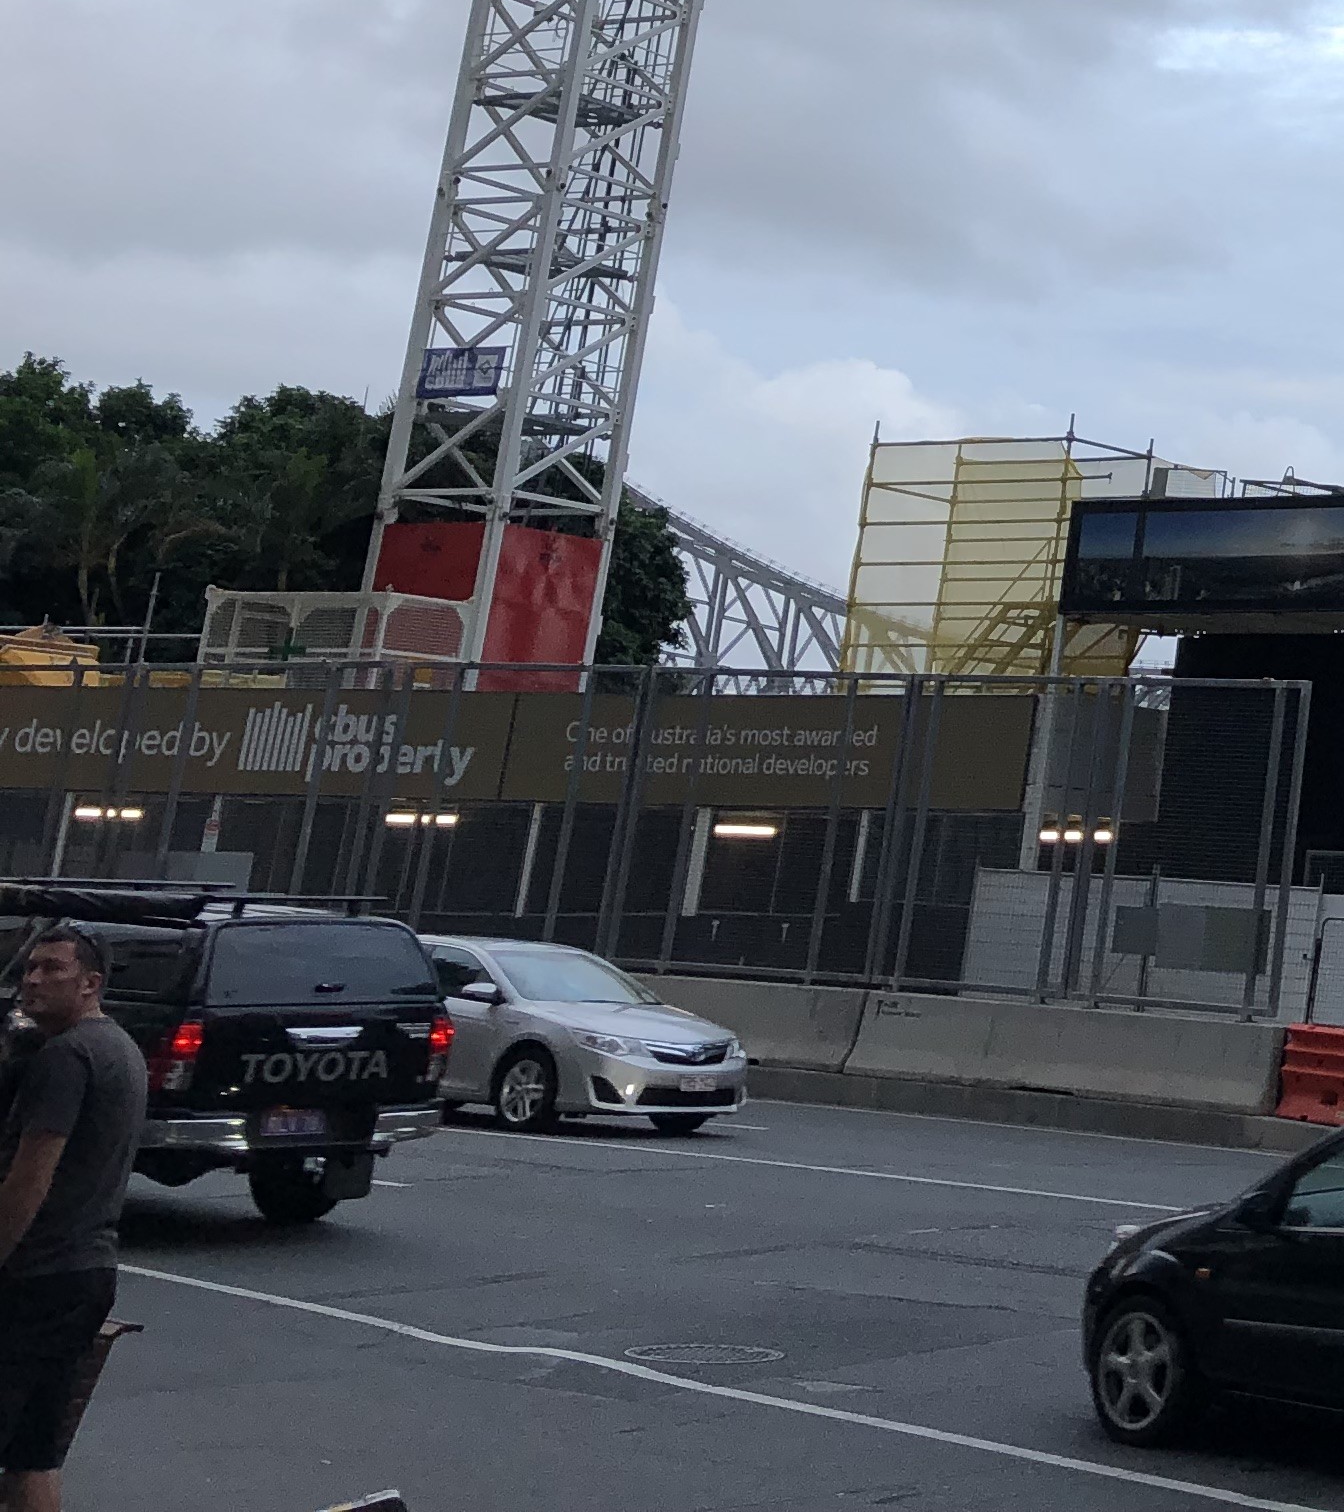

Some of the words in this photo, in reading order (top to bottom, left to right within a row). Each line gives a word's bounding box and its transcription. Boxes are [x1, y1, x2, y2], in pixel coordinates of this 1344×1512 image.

[189, 721, 232, 767] by
[739, 726, 790, 746] most
[794, 724, 878, 747] awared
[240, 1050, 388, 1084] TOYOTA
